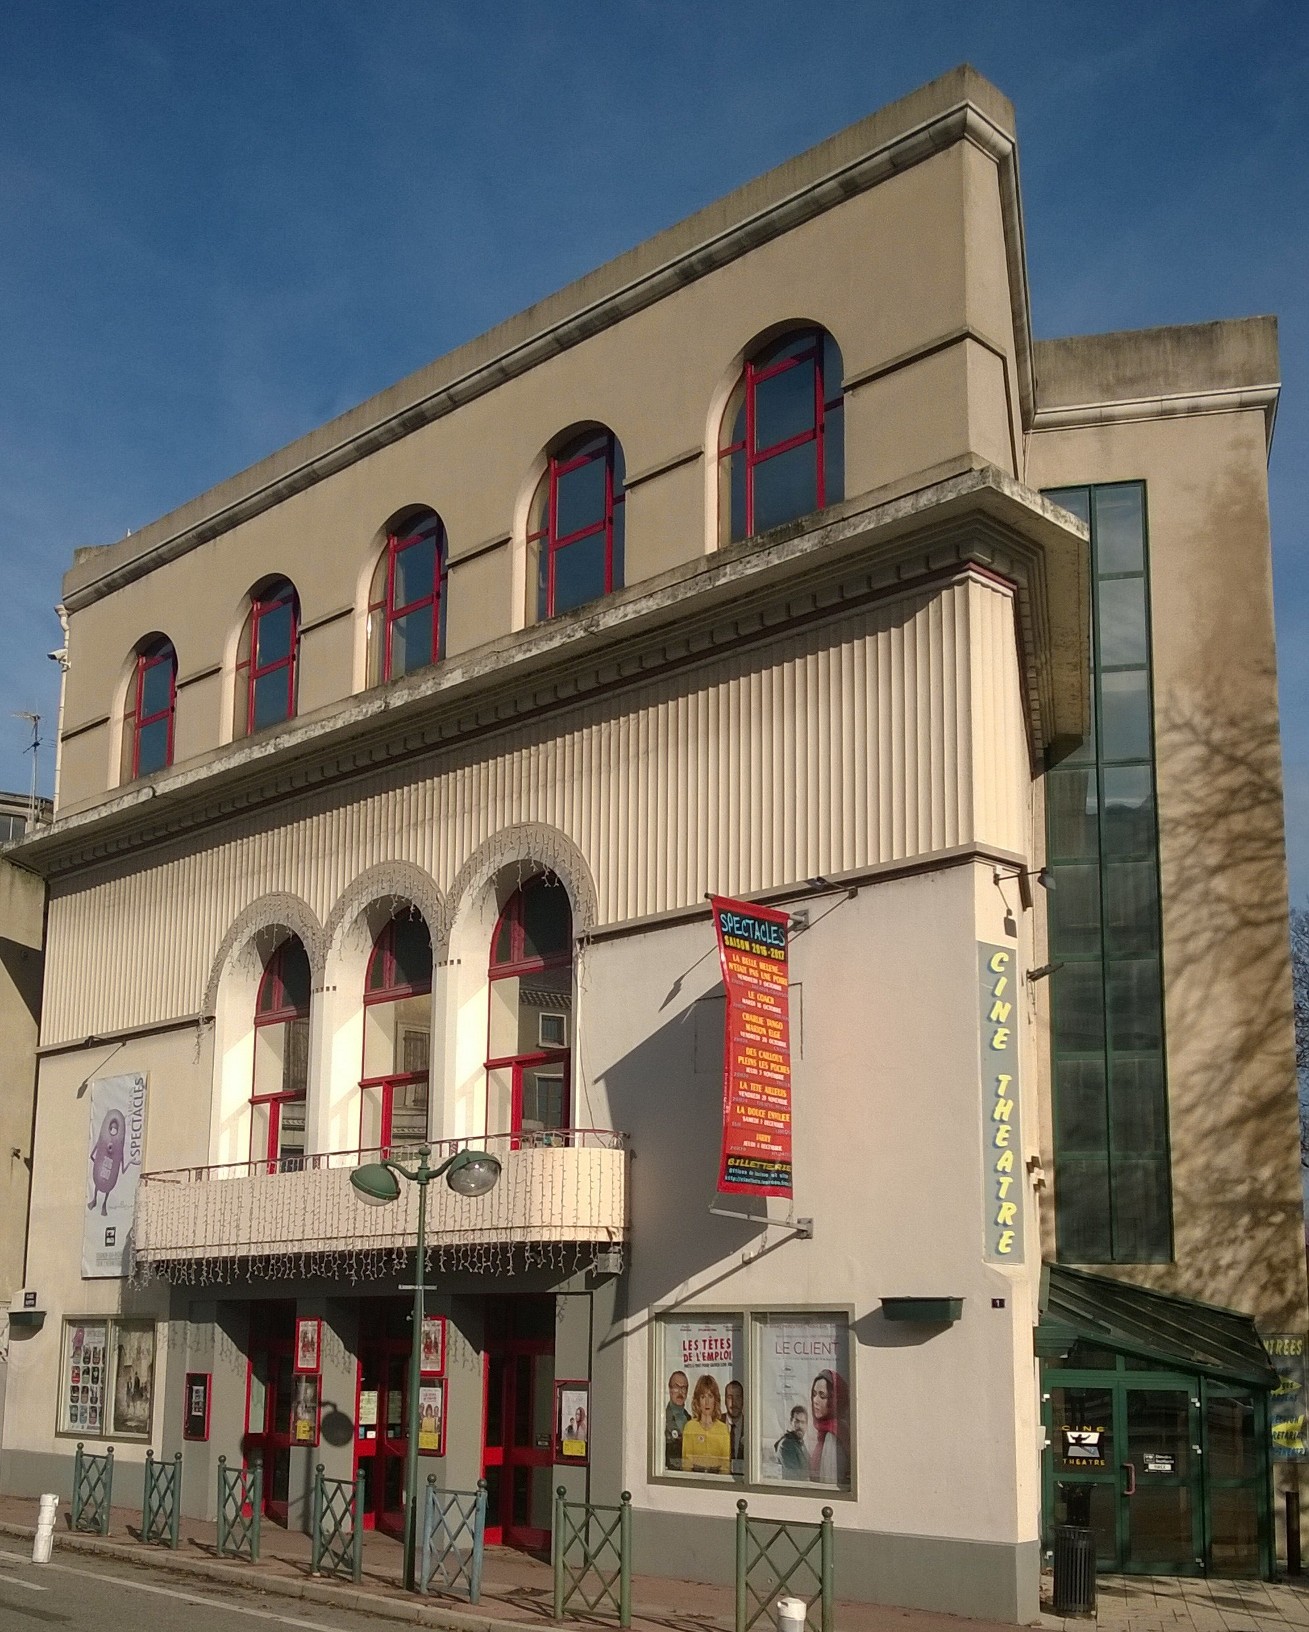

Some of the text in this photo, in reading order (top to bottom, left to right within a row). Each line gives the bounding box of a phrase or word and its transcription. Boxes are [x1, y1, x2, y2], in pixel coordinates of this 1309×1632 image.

[720, 913, 786, 947] SPECTACLES
[724, 935, 750, 951] SAISON
[758, 1060, 769, 1070] LES
[739, 1081, 748, 1090] LA
[736, 1105, 745, 1114] LA
[990, 952, 1017, 1254] CINE THEATRE
[130, 1077, 145, 1157] SPECTACLES
[728, 1157, 792, 1172] BILLETTERIE
[683, 1336, 731, 1351] LES TÊTES
[775, 1341, 840, 1355] LE CLIENT
[683, 1352, 693, 1363] DE
[1063, 1458, 1105, 1466] THEATRE
